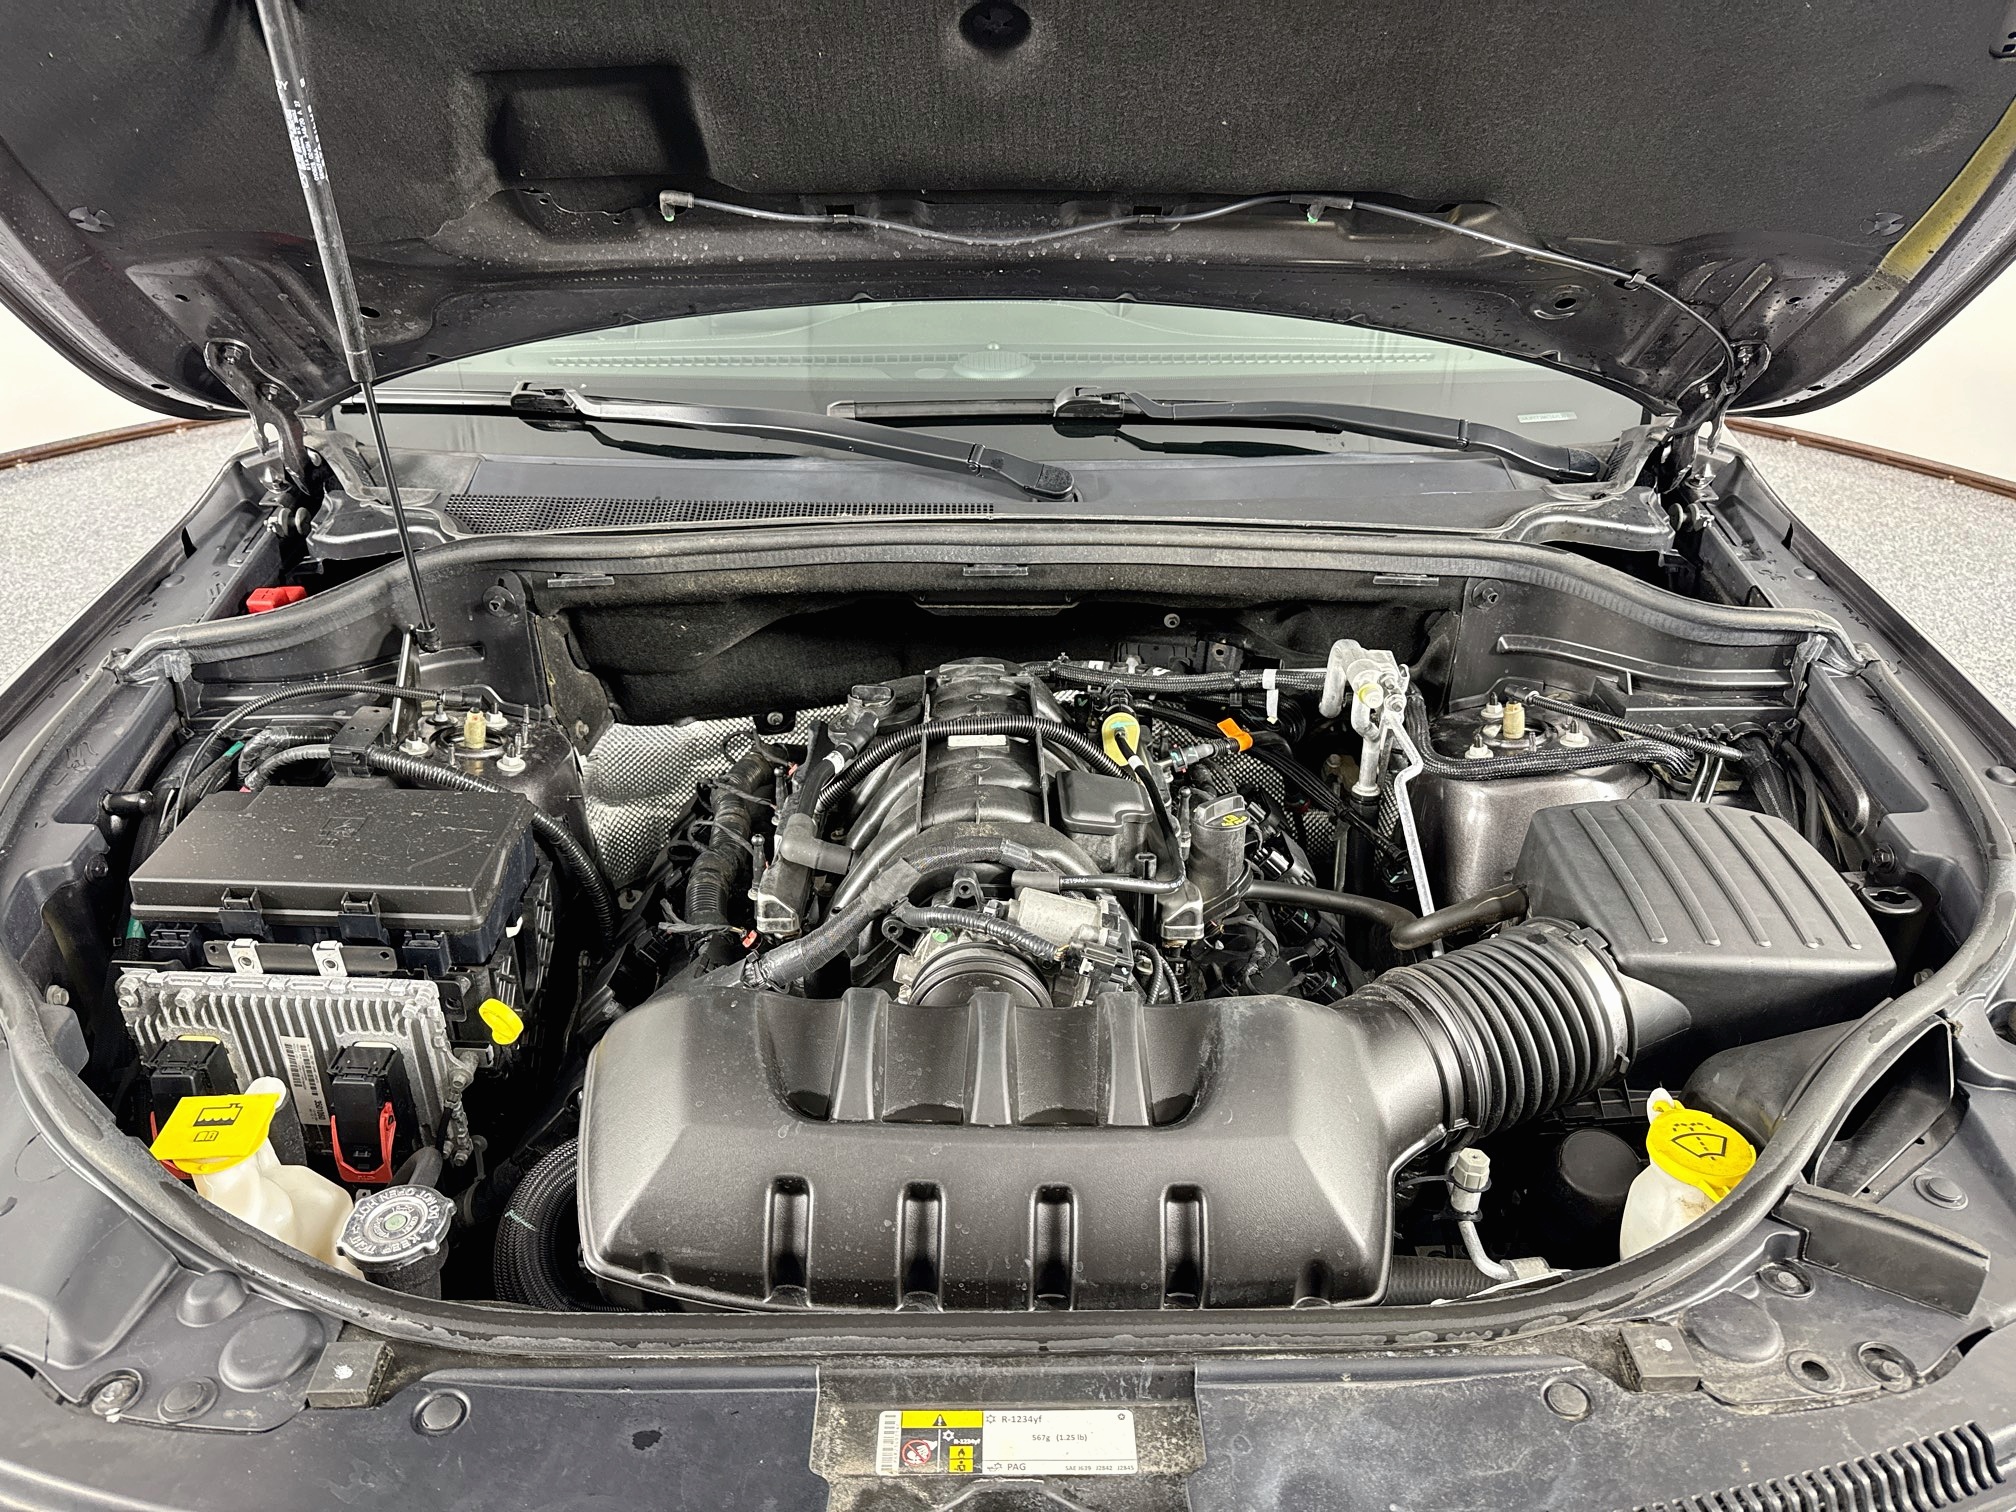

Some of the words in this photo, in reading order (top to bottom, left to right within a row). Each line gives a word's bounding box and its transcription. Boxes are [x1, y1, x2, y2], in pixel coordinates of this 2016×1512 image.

[380, 1187, 415, 1202] OPEN
[354, 1200, 378, 1220] HOT
[349, 1236, 377, 1254] TIGHT
[381, 1236, 421, 1255] KEEP
[1002, 1415, 1043, 1424] R-1234yf
[1032, 1434, 1051, 1442] 567g
[1056, 1434, 1075, 1442] (1.25
[1077, 1434, 1088, 1442] lb)
[1007, 1463, 1026, 1471] PAG
